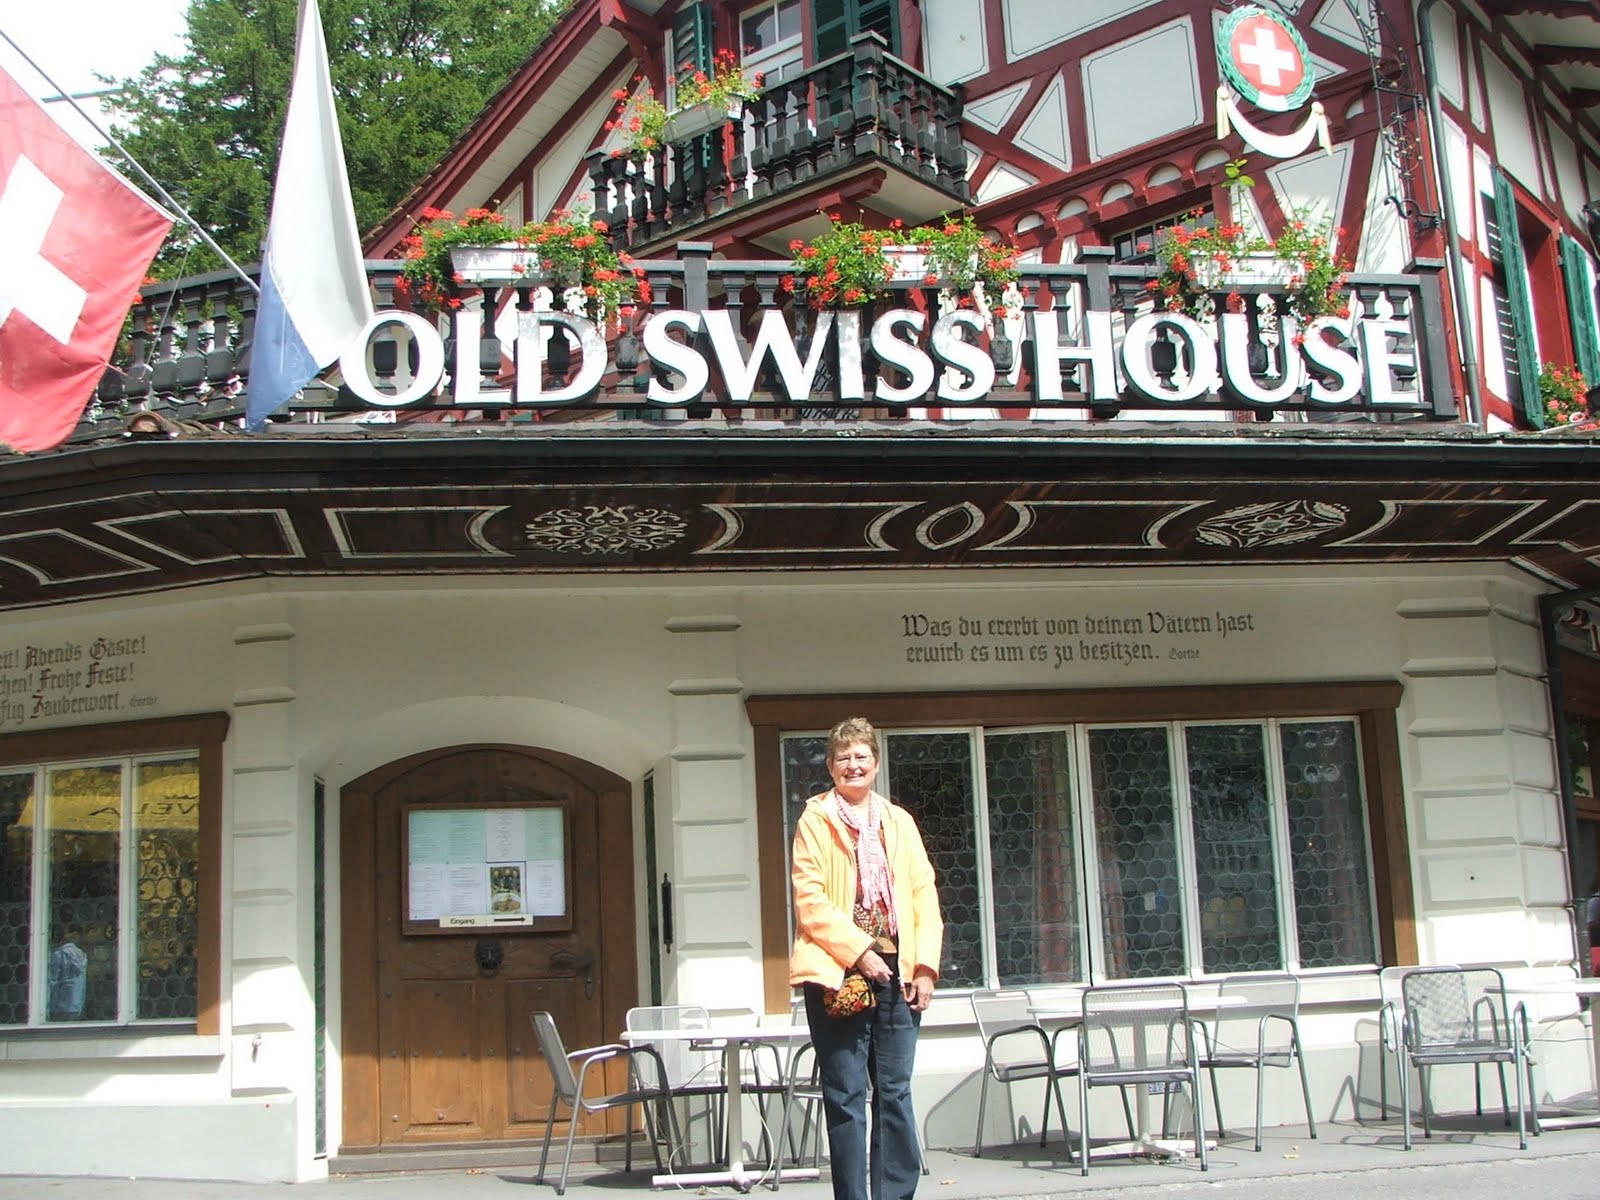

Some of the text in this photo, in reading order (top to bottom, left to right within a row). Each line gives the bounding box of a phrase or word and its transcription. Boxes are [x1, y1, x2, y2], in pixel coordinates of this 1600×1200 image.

[339, 307, 1424, 408] OLD SWISS HOUSE
[902, 610, 1255, 639] Was du ererbt von deinen Vätern hast
[23, 640, 81, 671] Abends
[906, 640, 1160, 669] erwirb es um es zu besitzen.
[36, 668, 82, 694] Frohe
[85, 661, 135, 688] Feste!
[29, 691, 125, 719] Zauberwort.
